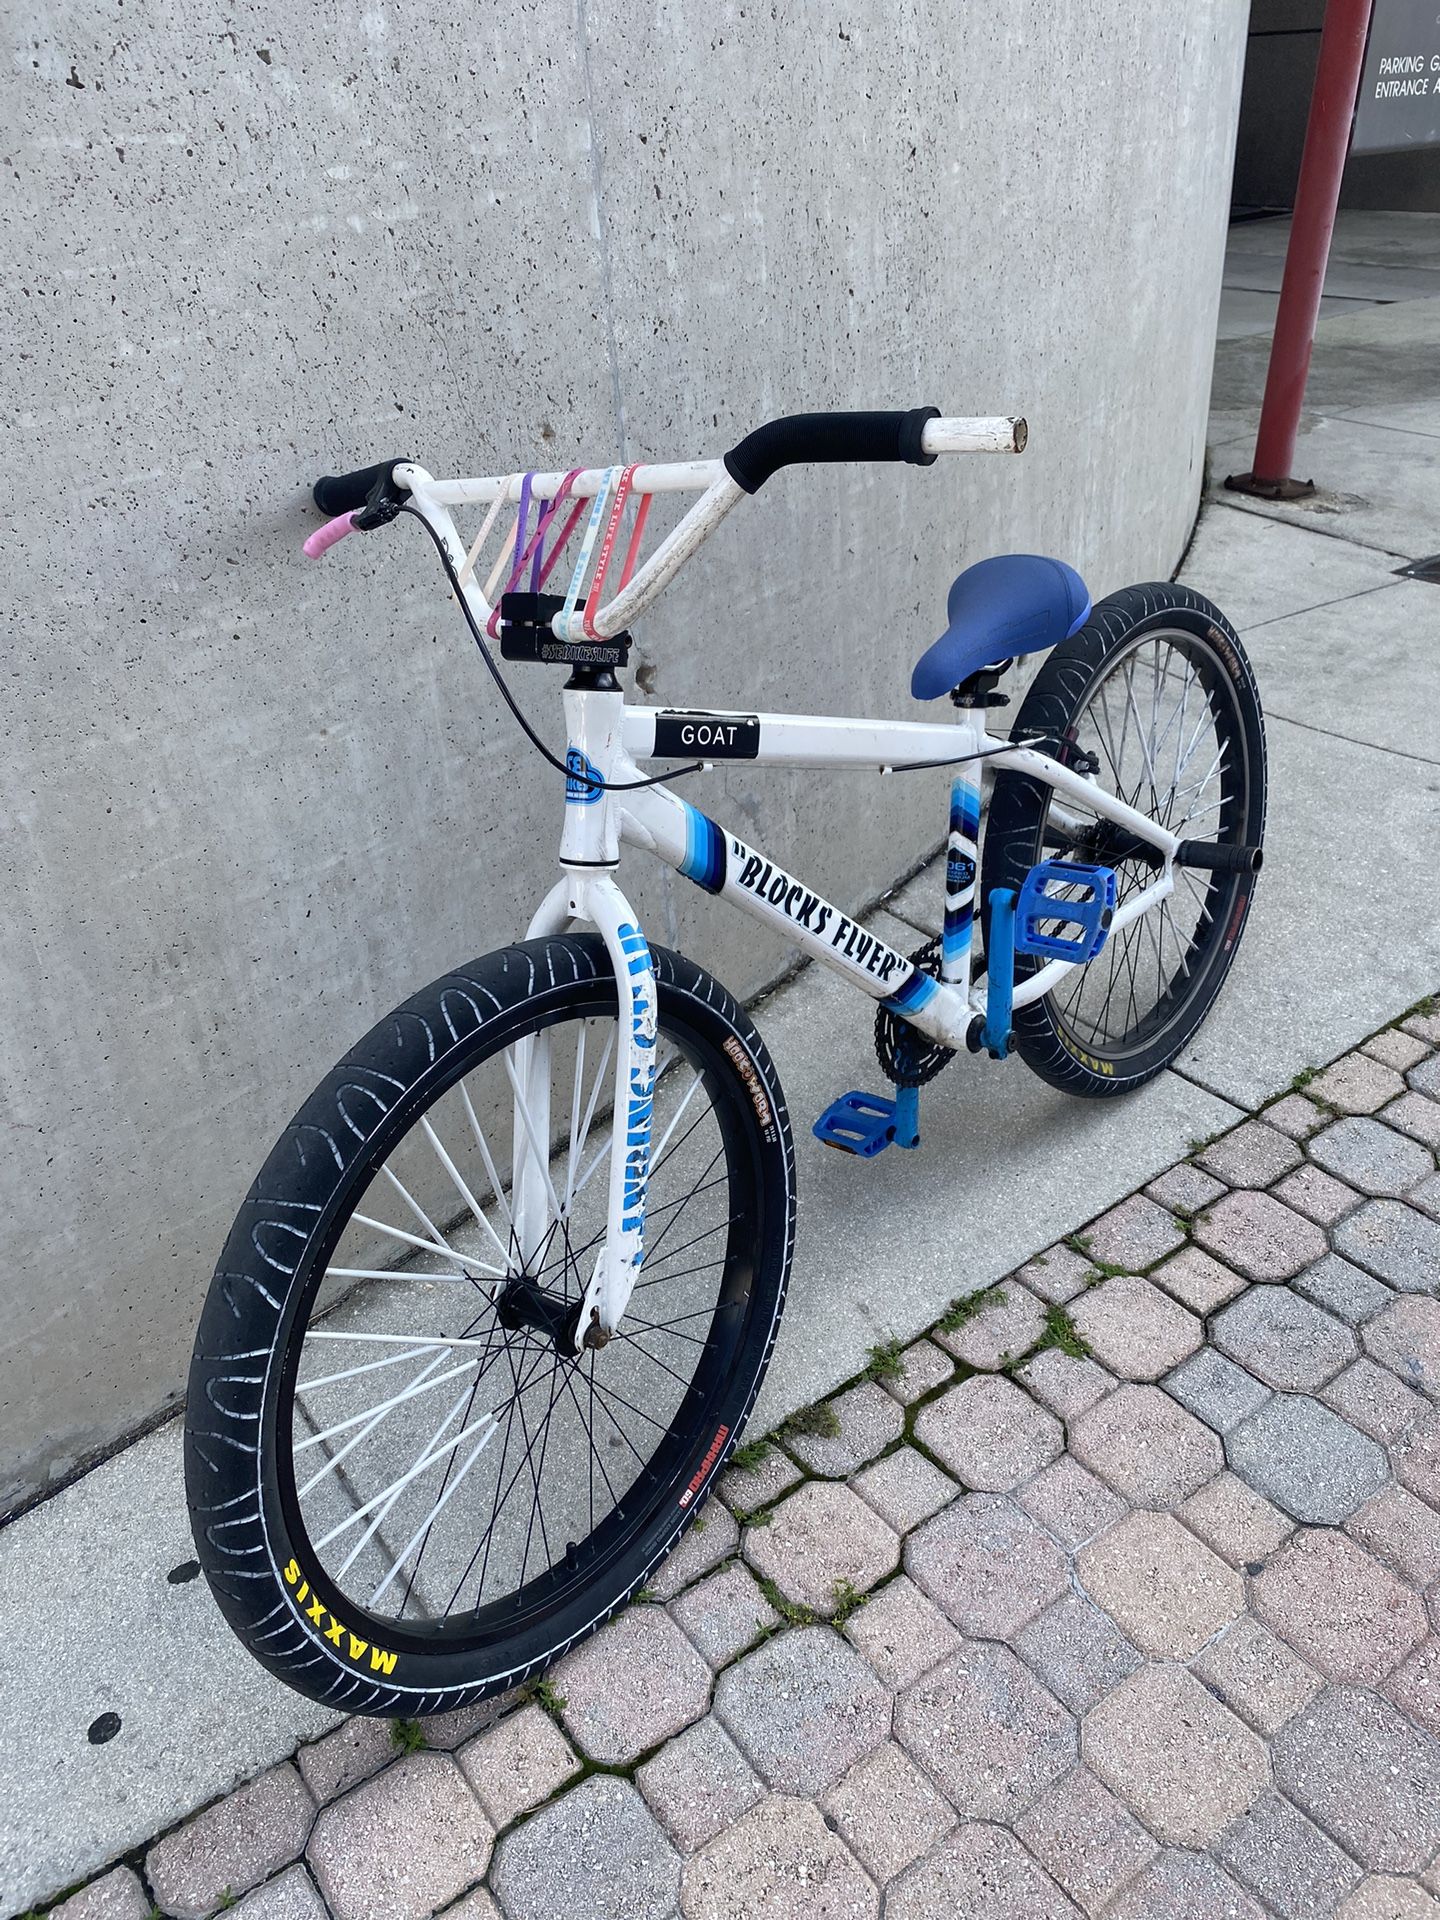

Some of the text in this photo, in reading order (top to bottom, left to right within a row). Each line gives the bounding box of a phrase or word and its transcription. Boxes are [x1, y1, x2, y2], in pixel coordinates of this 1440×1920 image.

[1379, 54, 1440, 74] PARKING G
[1375, 79, 1429, 98] ENTRANCE
[681, 725, 738, 746] GOAT
[283, 1558, 399, 1676] MAXXIS
